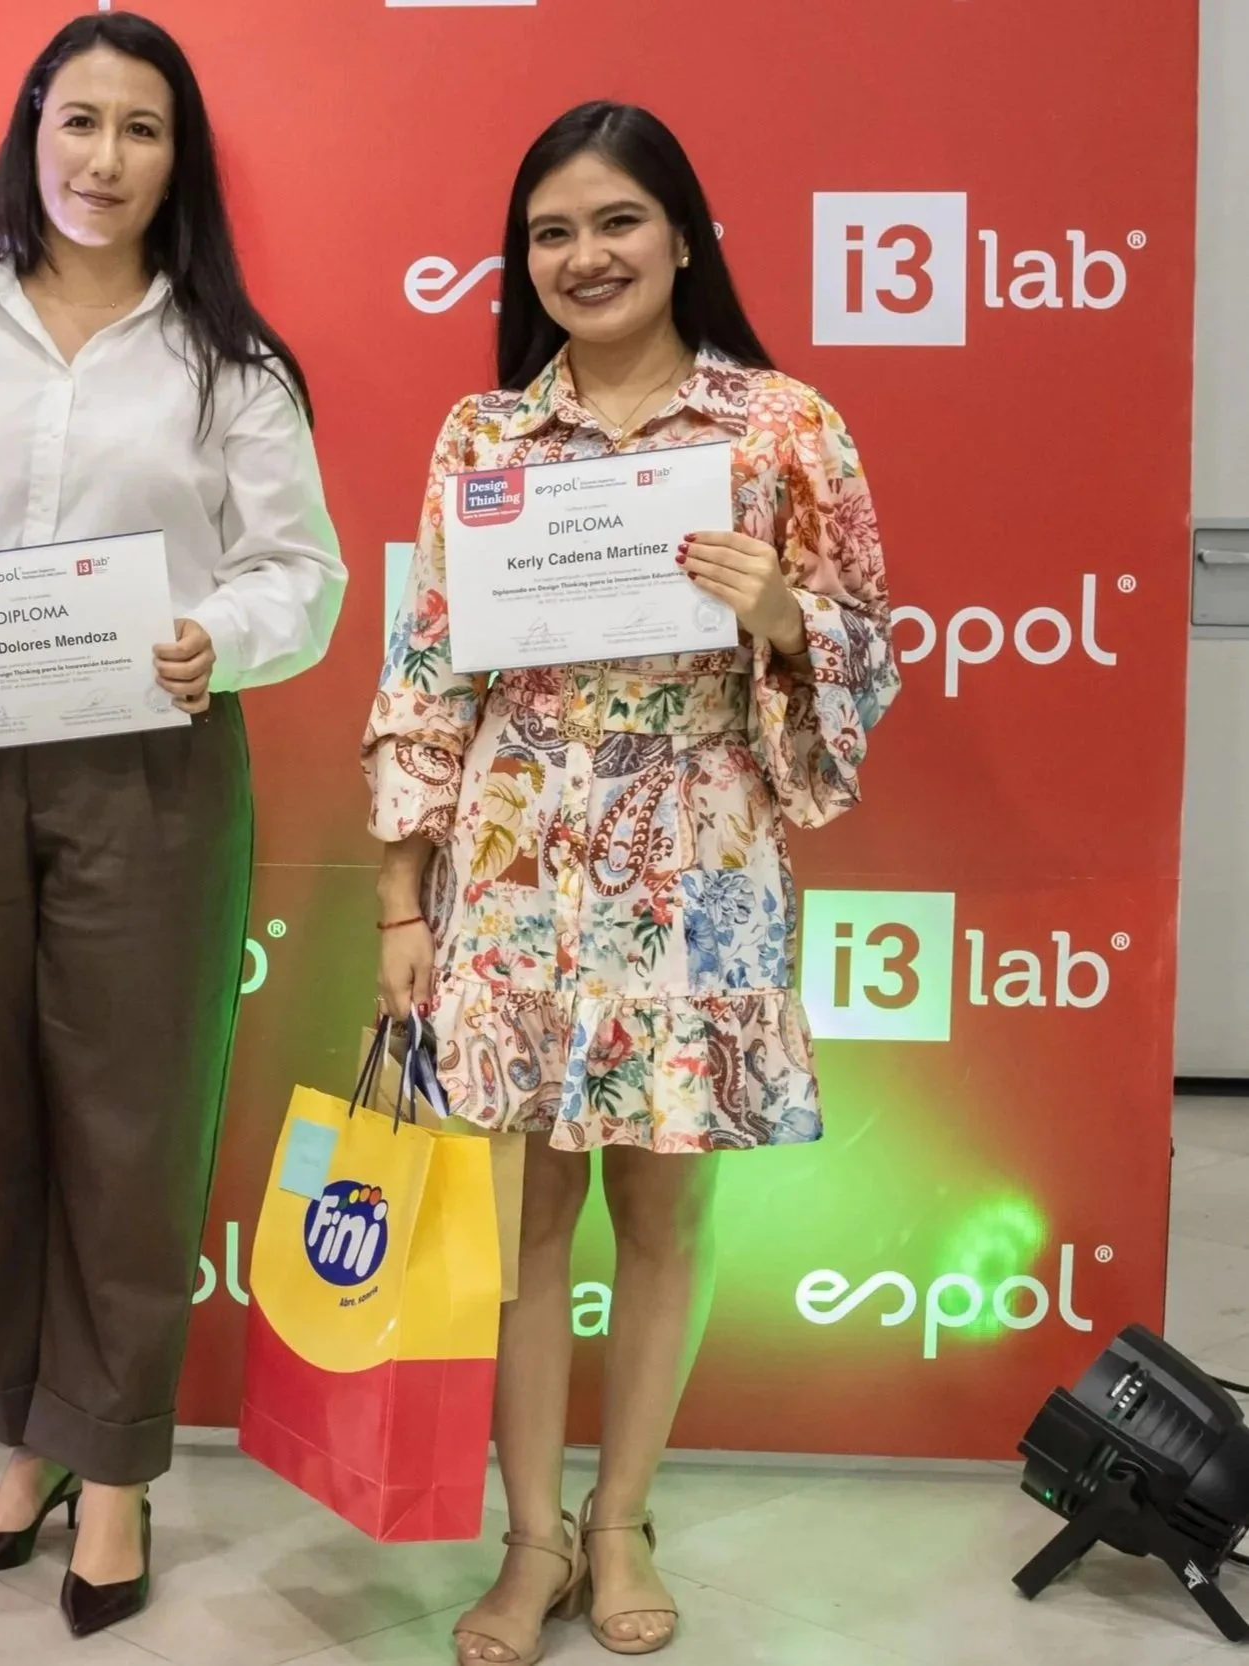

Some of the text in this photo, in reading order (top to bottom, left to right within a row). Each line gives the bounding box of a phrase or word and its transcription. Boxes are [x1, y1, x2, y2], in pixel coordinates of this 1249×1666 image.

[470, 480, 508, 494] Design
[469, 493, 520, 507] Thinking
[549, 516, 624, 535] DIPLOMA
[507, 556, 544, 570] Kerly
[548, 549, 602, 565] Cadena
[55, 630, 118, 648] Mendoza
[308, 1195, 389, 1277] Fini
